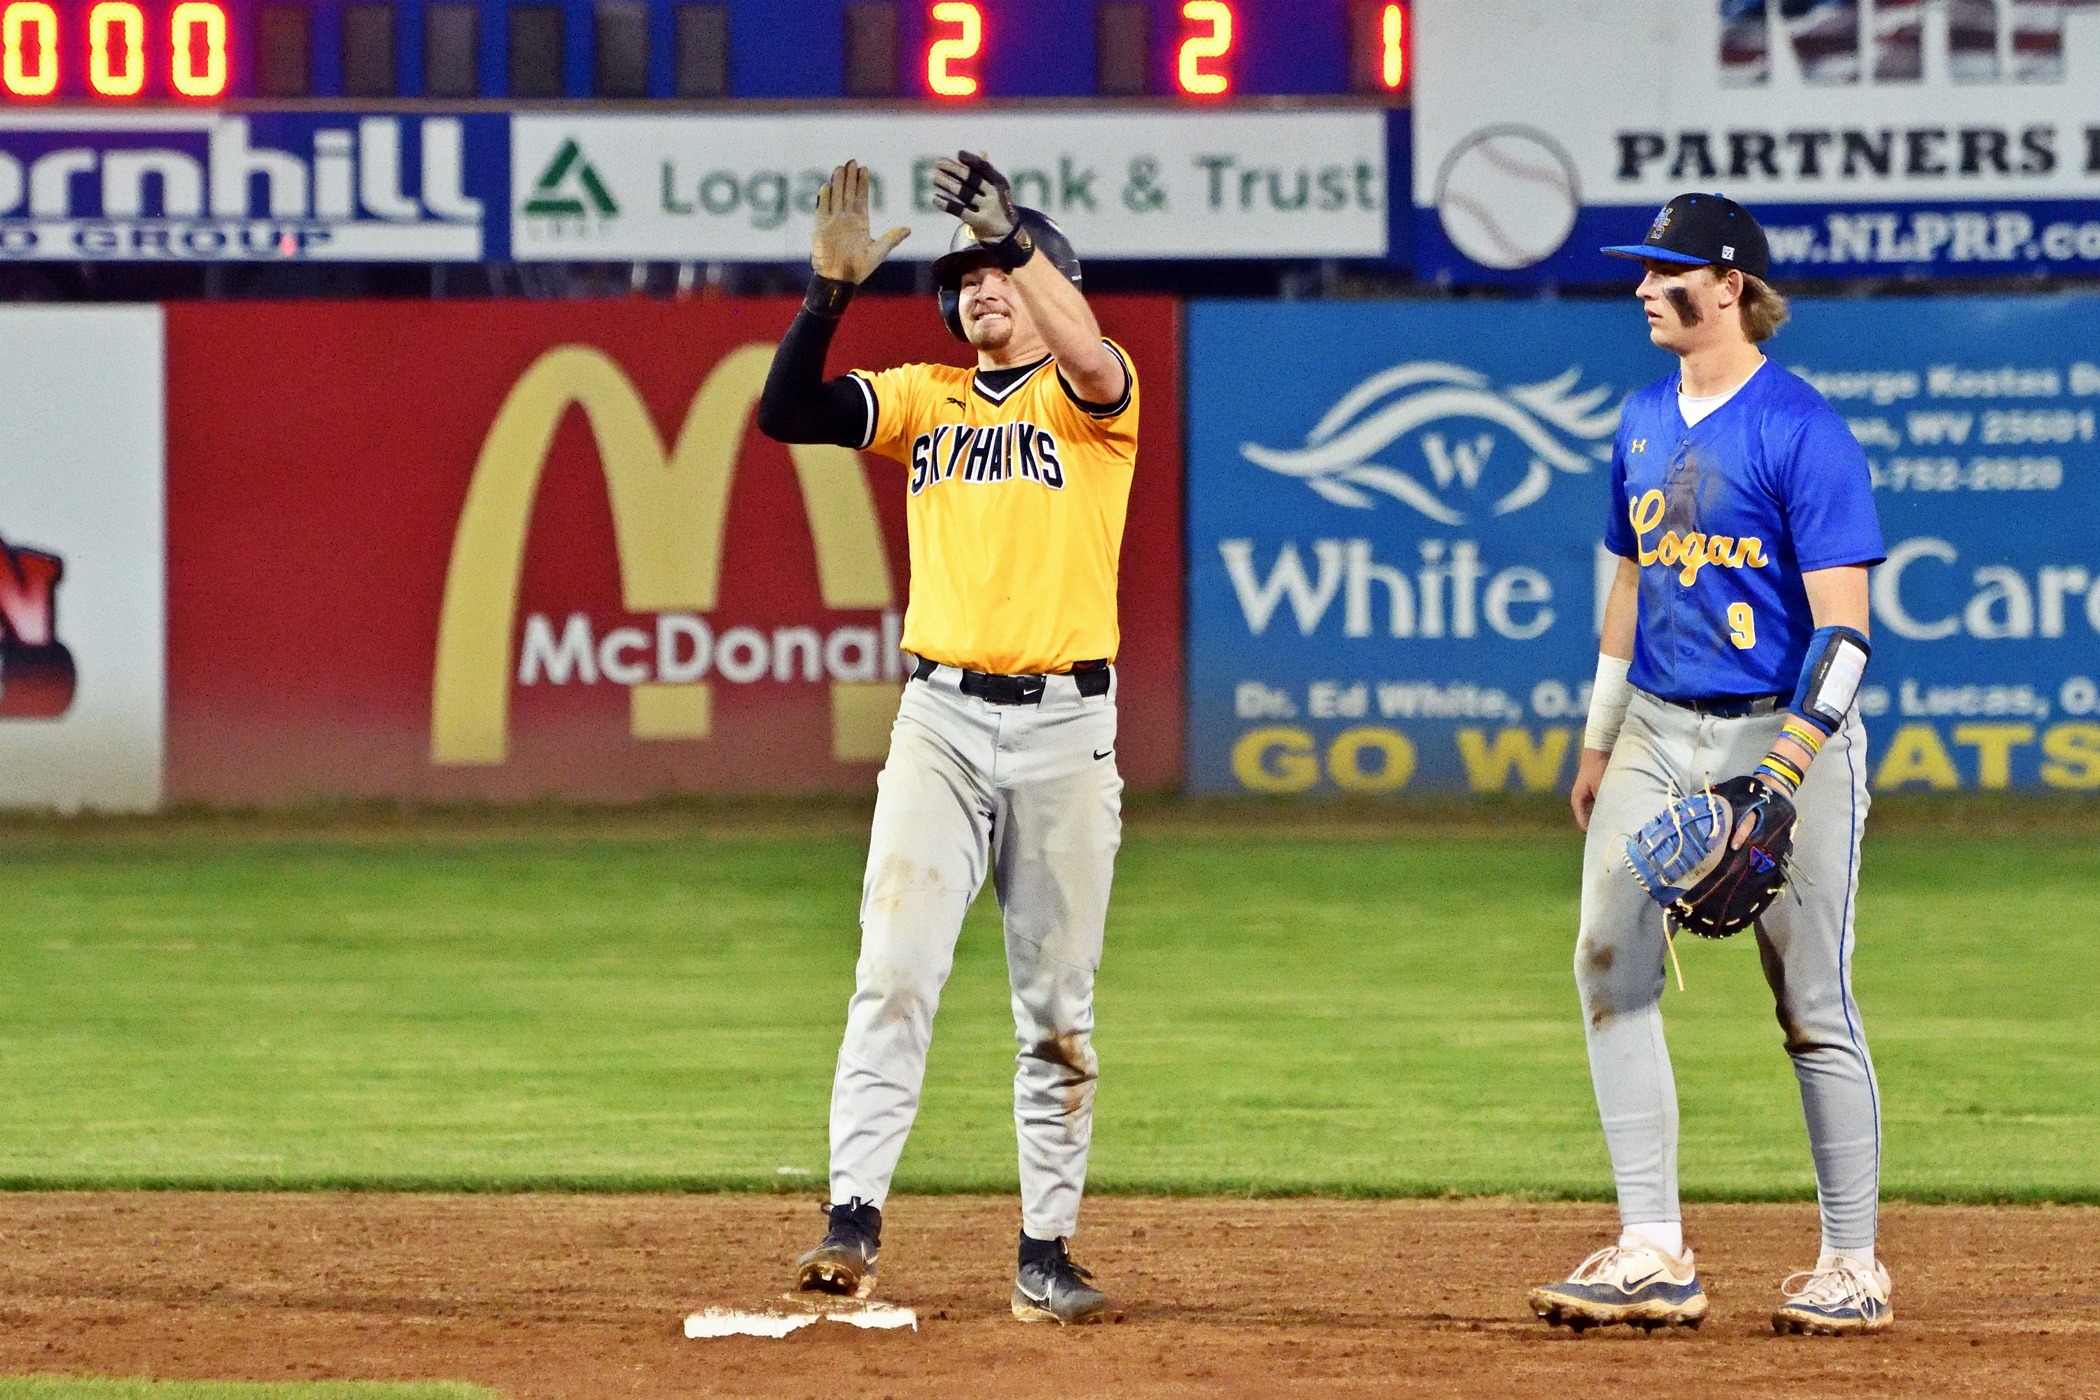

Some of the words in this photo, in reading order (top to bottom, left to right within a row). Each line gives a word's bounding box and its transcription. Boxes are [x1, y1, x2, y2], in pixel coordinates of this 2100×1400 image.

[2, 1, 58, 97] 0
[89, 1, 144, 97] 0
[171, 1, 227, 97] 0
[926, 1, 981, 97] 2
[1176, 1, 1233, 96] 2
[1381, 2, 1402, 87] 1
[911, 156, 1097, 214] Bnk
[1121, 155, 1167, 211] &
[1191, 153, 1381, 213] Trust
[1615, 127, 2058, 181] PARTNERS
[1419, 433, 1496, 489] W
[1629, 489, 1770, 586] Logan
[1218, 537, 1556, 641] White
[1869, 536, 2100, 641] Car
[1727, 602, 1757, 650] 9
[519, 613, 916, 686] McDonal
[1231, 726, 1417, 792] GO
